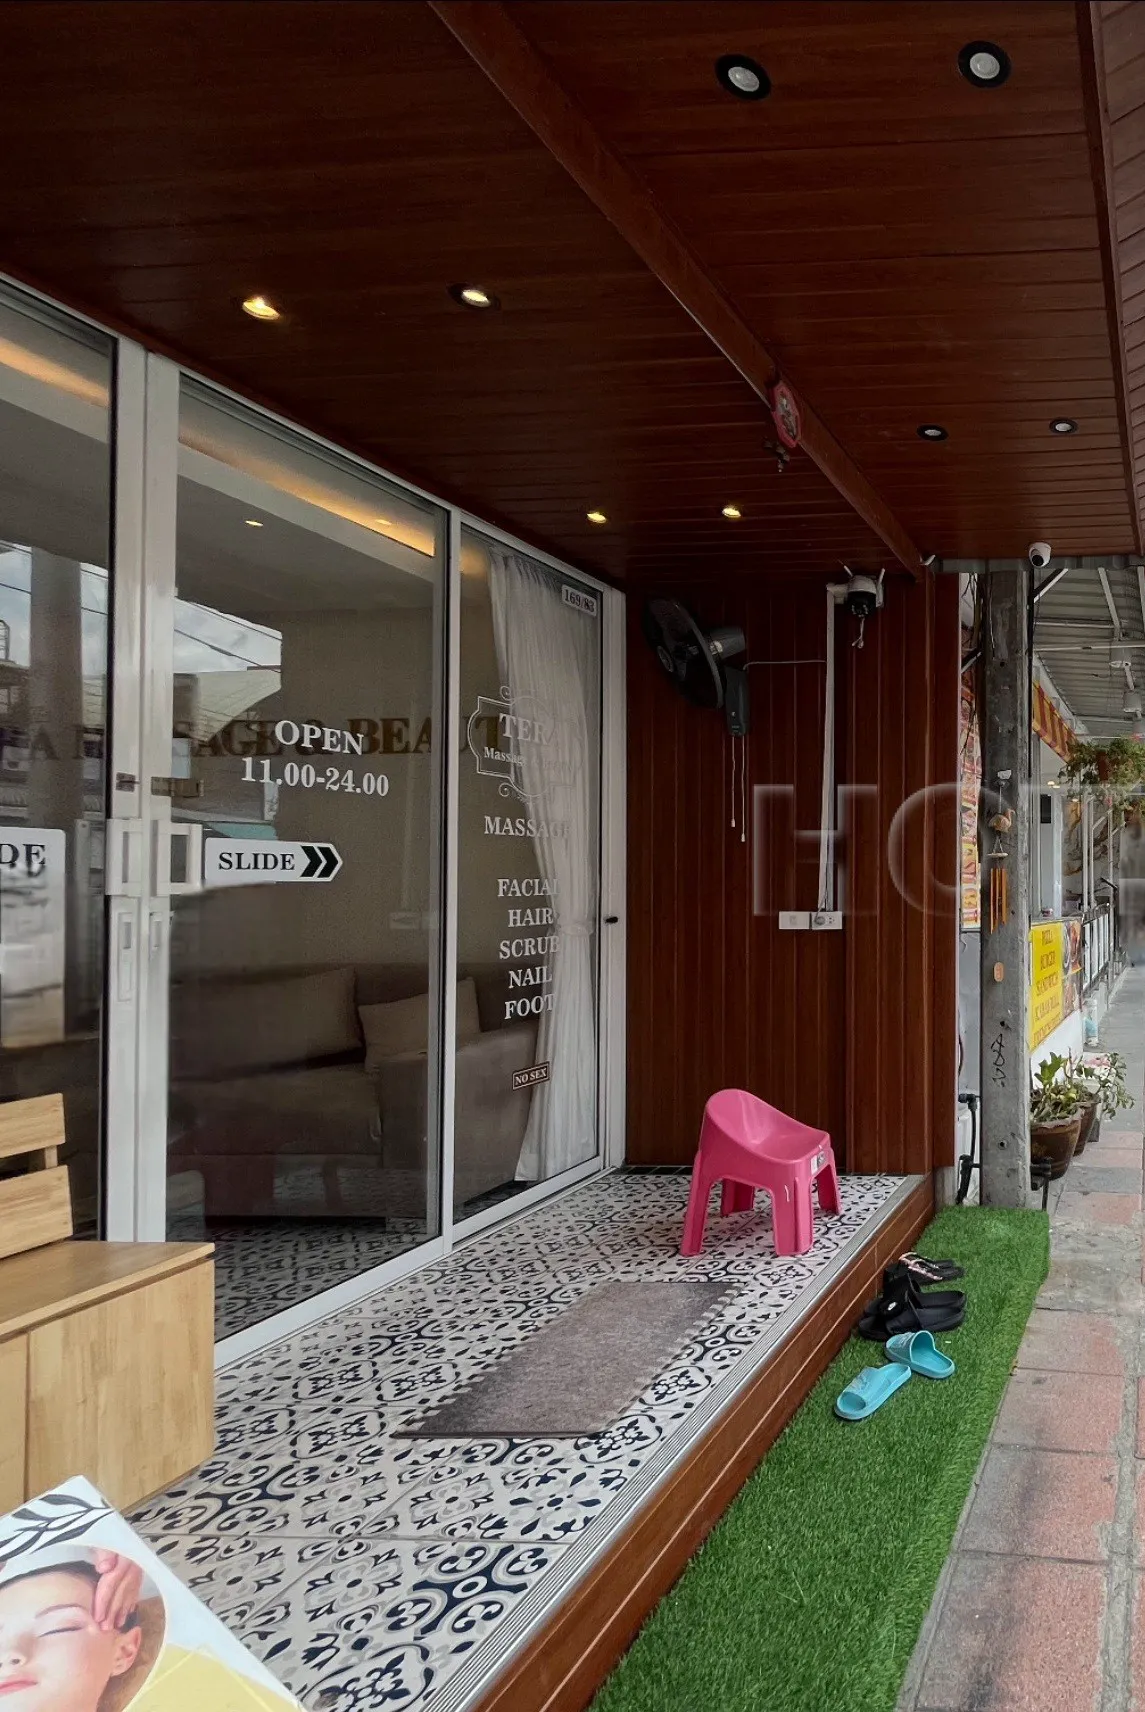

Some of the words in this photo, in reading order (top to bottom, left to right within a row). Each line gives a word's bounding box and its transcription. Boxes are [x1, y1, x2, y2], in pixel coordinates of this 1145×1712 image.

[564, 589, 595, 613] 169/83
[274, 719, 365, 756] OPEN
[241, 757, 389, 798] 11.00-24.00
[218, 852, 296, 872] SLIDE
[507, 908, 554, 928] HAIR
[499, 935, 561, 960] SCRUB
[508, 966, 553, 989] NAIL
[504, 994, 557, 1020] FOOT
[514, 1073, 528, 1086] NO
[529, 1068, 547, 1082] SEX
